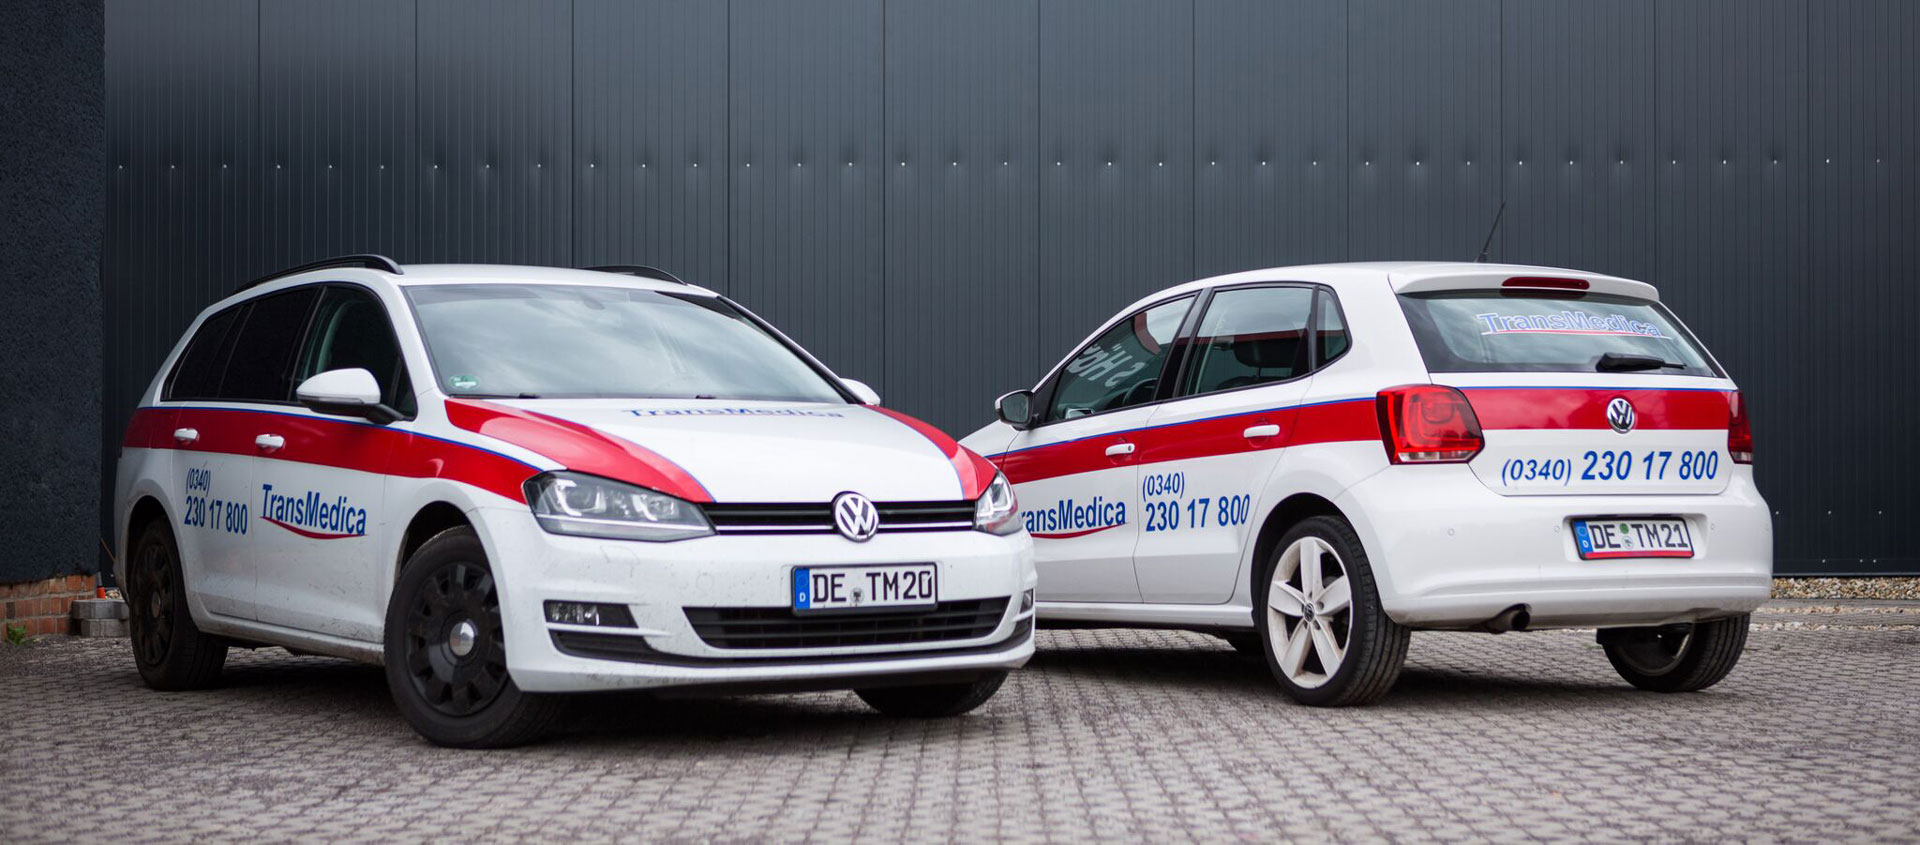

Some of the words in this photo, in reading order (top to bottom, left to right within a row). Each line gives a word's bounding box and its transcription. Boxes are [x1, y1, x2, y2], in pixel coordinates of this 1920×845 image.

[1476, 311, 1664, 338] TransMedica
[185, 467, 212, 498] (0340)
[1501, 458, 1573, 487] (0340)
[1581, 450, 1633, 481] 230
[1642, 450, 1673, 481] 17
[1679, 450, 1719, 481] 800
[1142, 471, 1186, 503] (0340)
[184, 495, 206, 528] 230
[208, 498, 223, 530] 17
[225, 499, 249, 536] 800
[261, 483, 368, 536] TransMedica
[1020, 496, 1126, 533] ansMedica
[1145, 500, 1180, 533] 230
[1187, 497, 1210, 529] 17
[1217, 493, 1251, 527] 800
[1588, 524, 1622, 550] DE
[1630, 523, 1689, 549] TM21
[812, 573, 848, 604] DE
[865, 570, 933, 602] TM20
